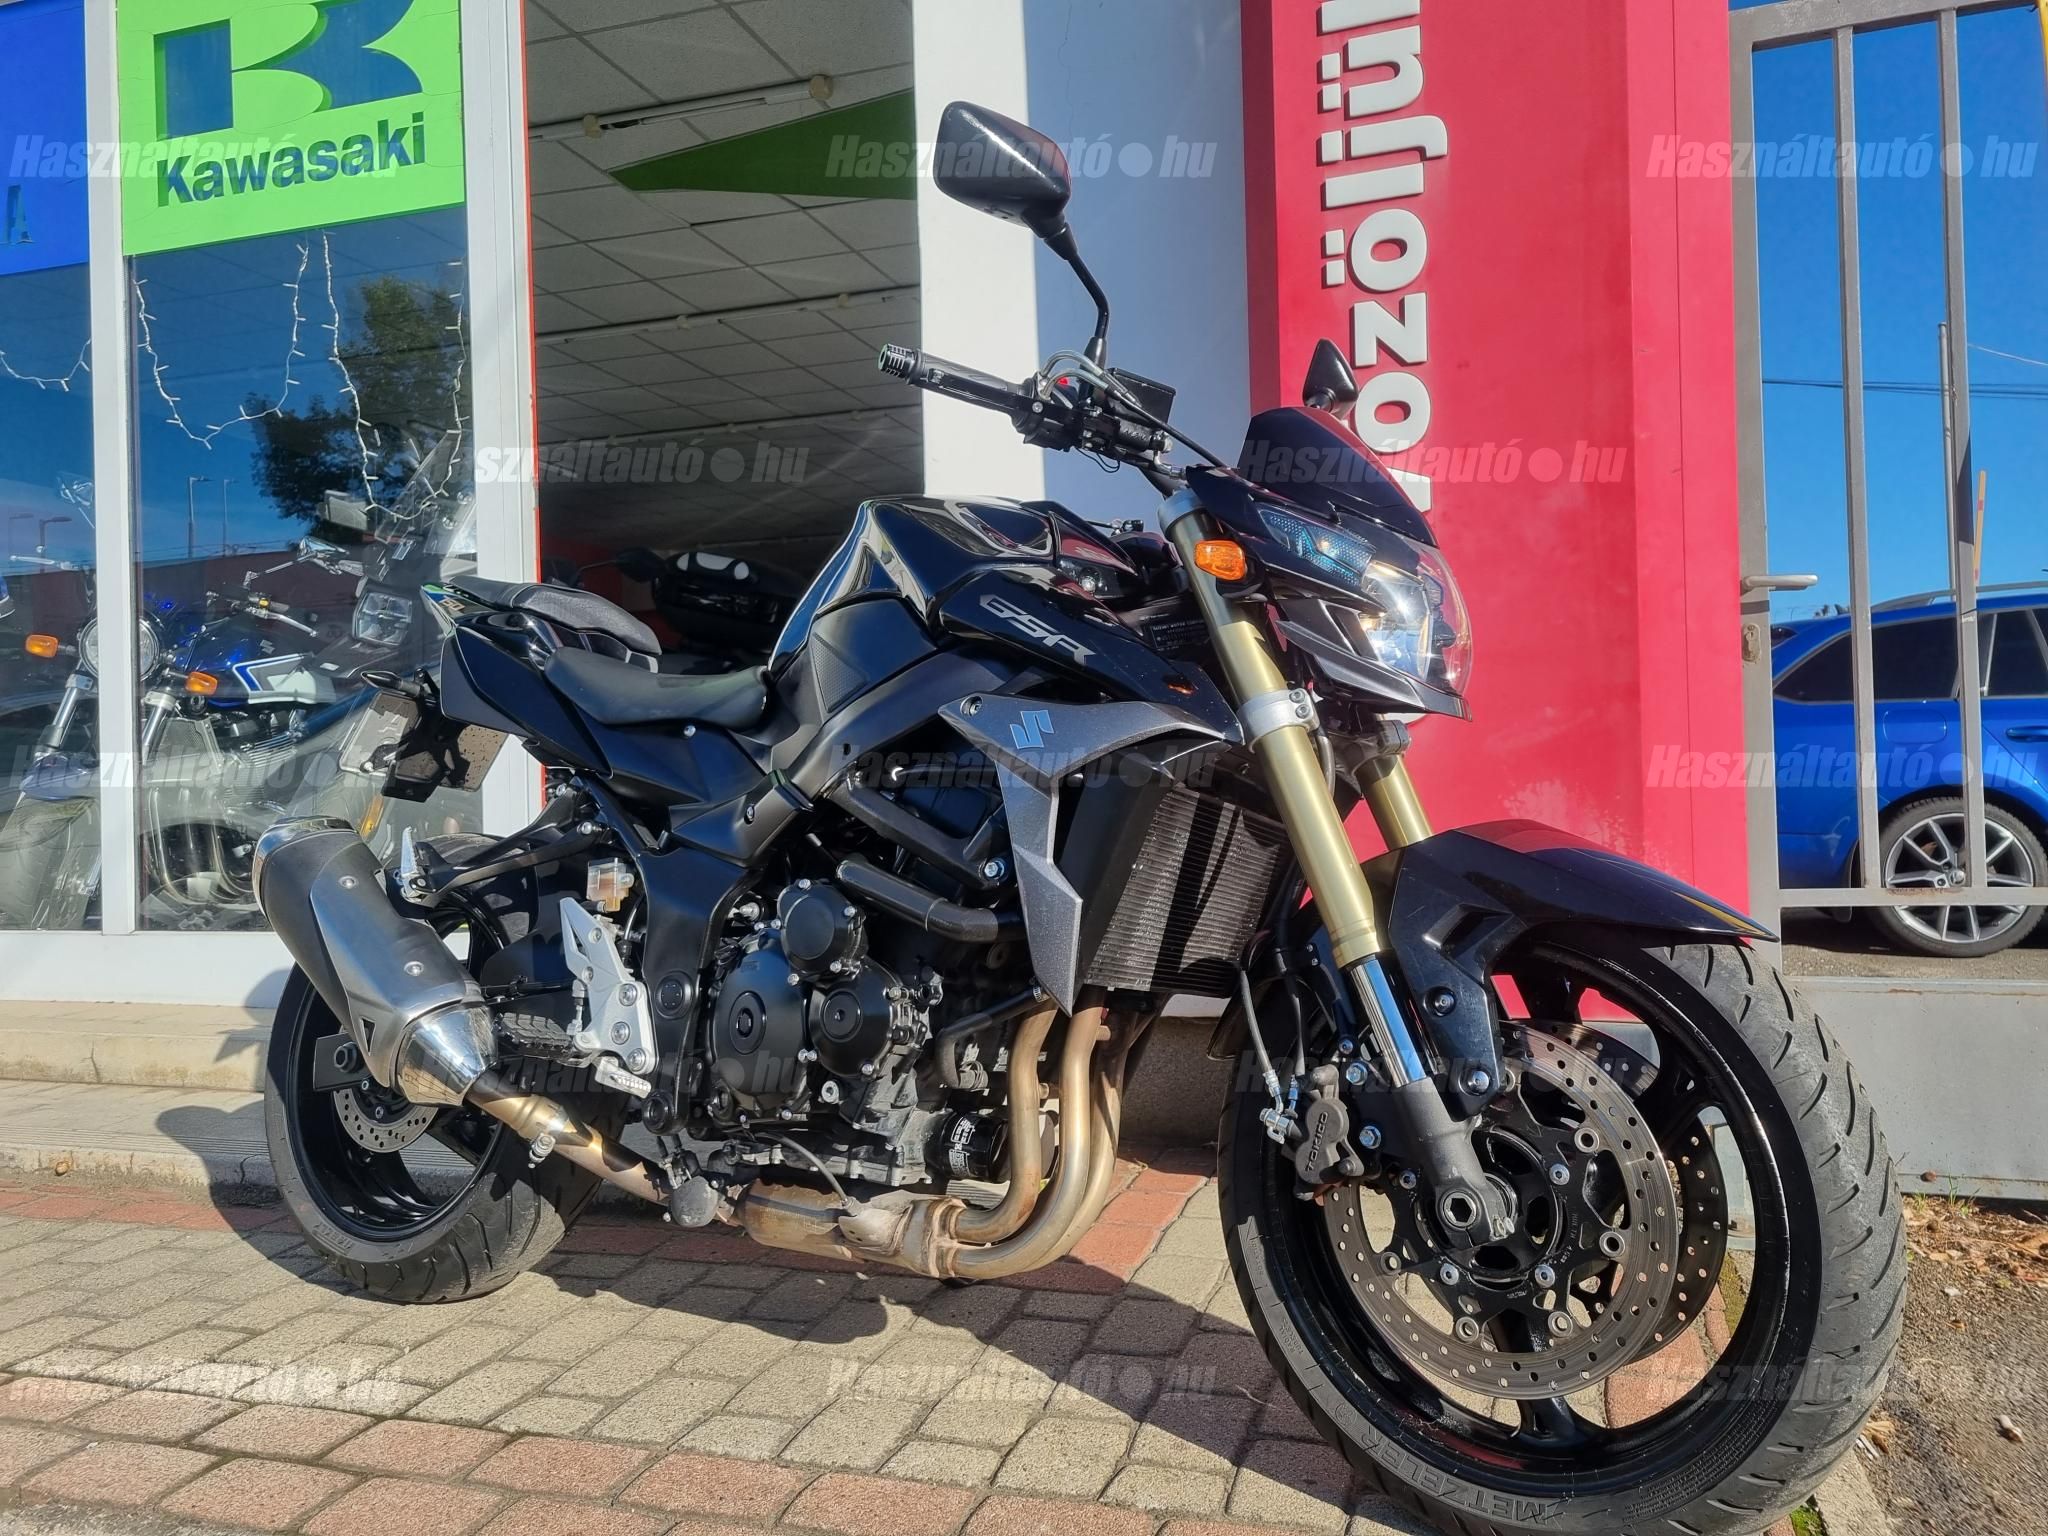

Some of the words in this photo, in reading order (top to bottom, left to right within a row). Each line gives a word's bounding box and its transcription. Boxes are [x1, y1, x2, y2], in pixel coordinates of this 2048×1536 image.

[156, 111, 426, 208] Kawasaki
[979, 594, 1097, 666] GSR
[1304, 1111, 1328, 1171] TOKICO
[1360, 1425, 1548, 1525] METZELER
